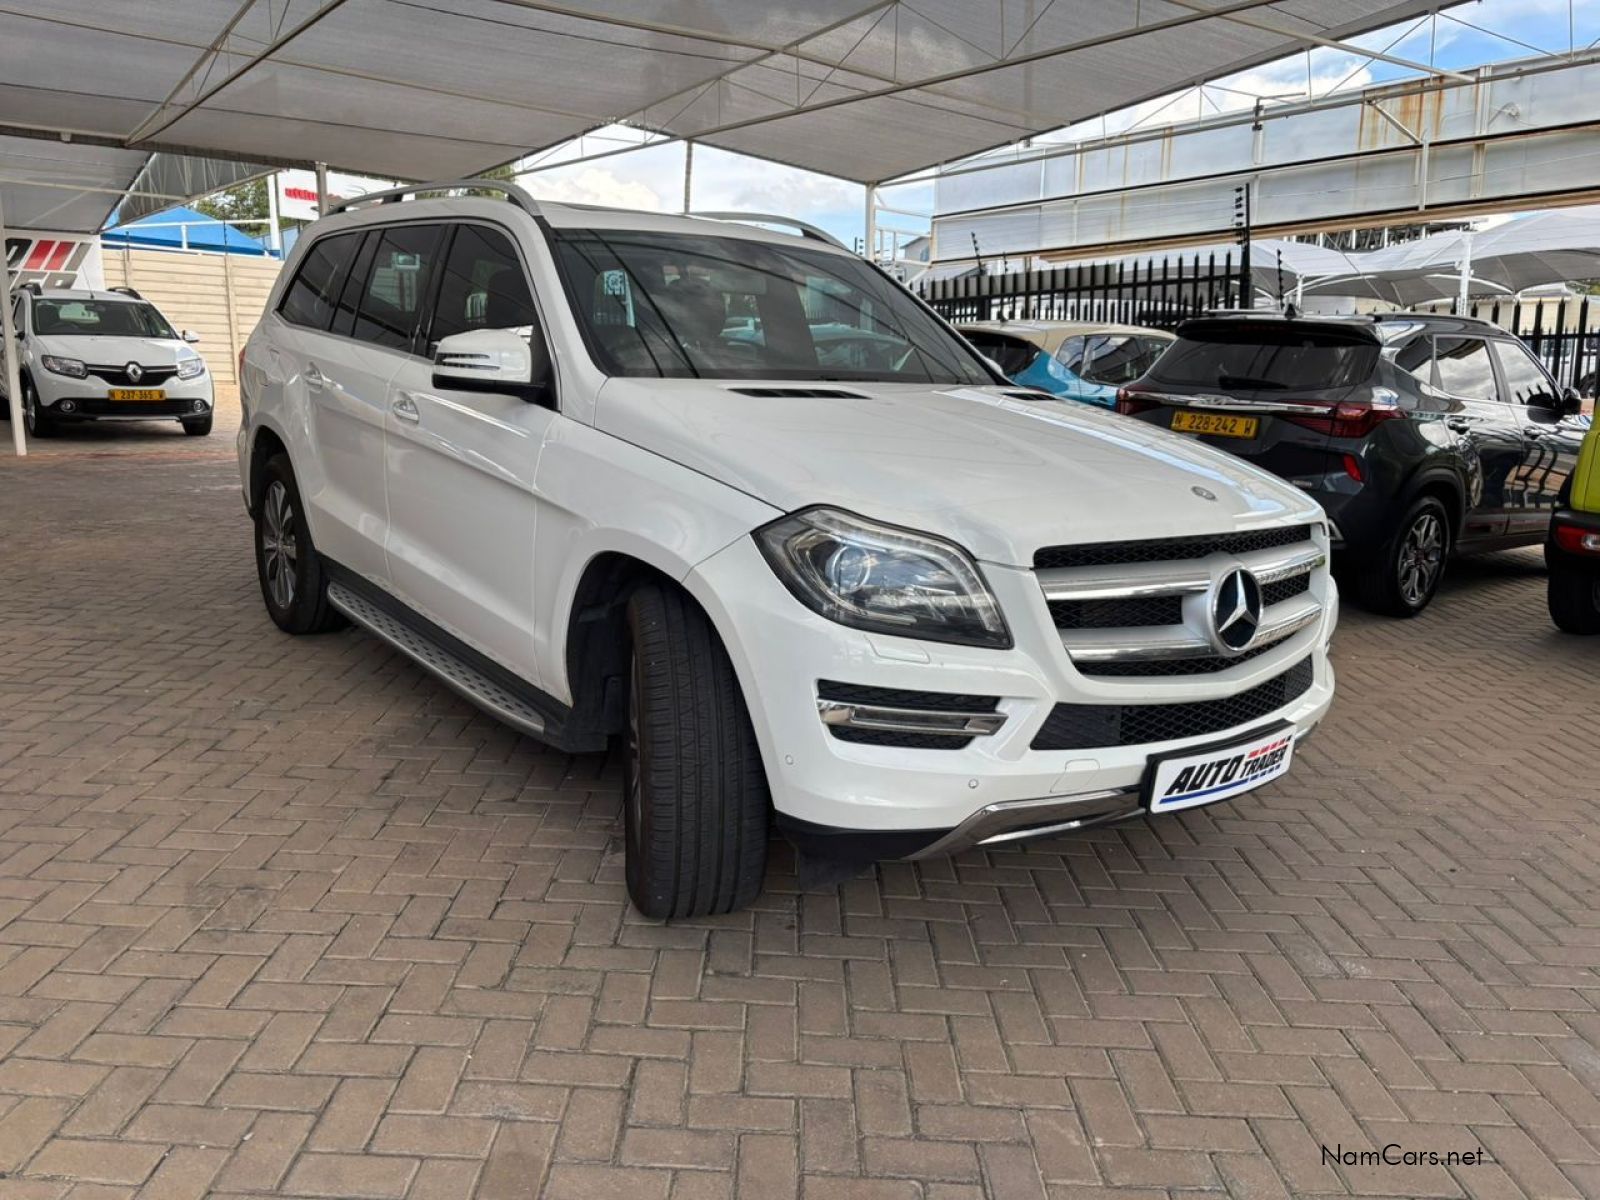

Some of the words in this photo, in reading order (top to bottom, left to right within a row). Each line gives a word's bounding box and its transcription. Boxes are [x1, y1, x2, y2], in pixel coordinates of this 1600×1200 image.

[1174, 414, 1184, 426] N
[1189, 414, 1237, 433] 228-242
[1164, 754, 1245, 796] AUTO
[1240, 744, 1289, 778] TRADER
